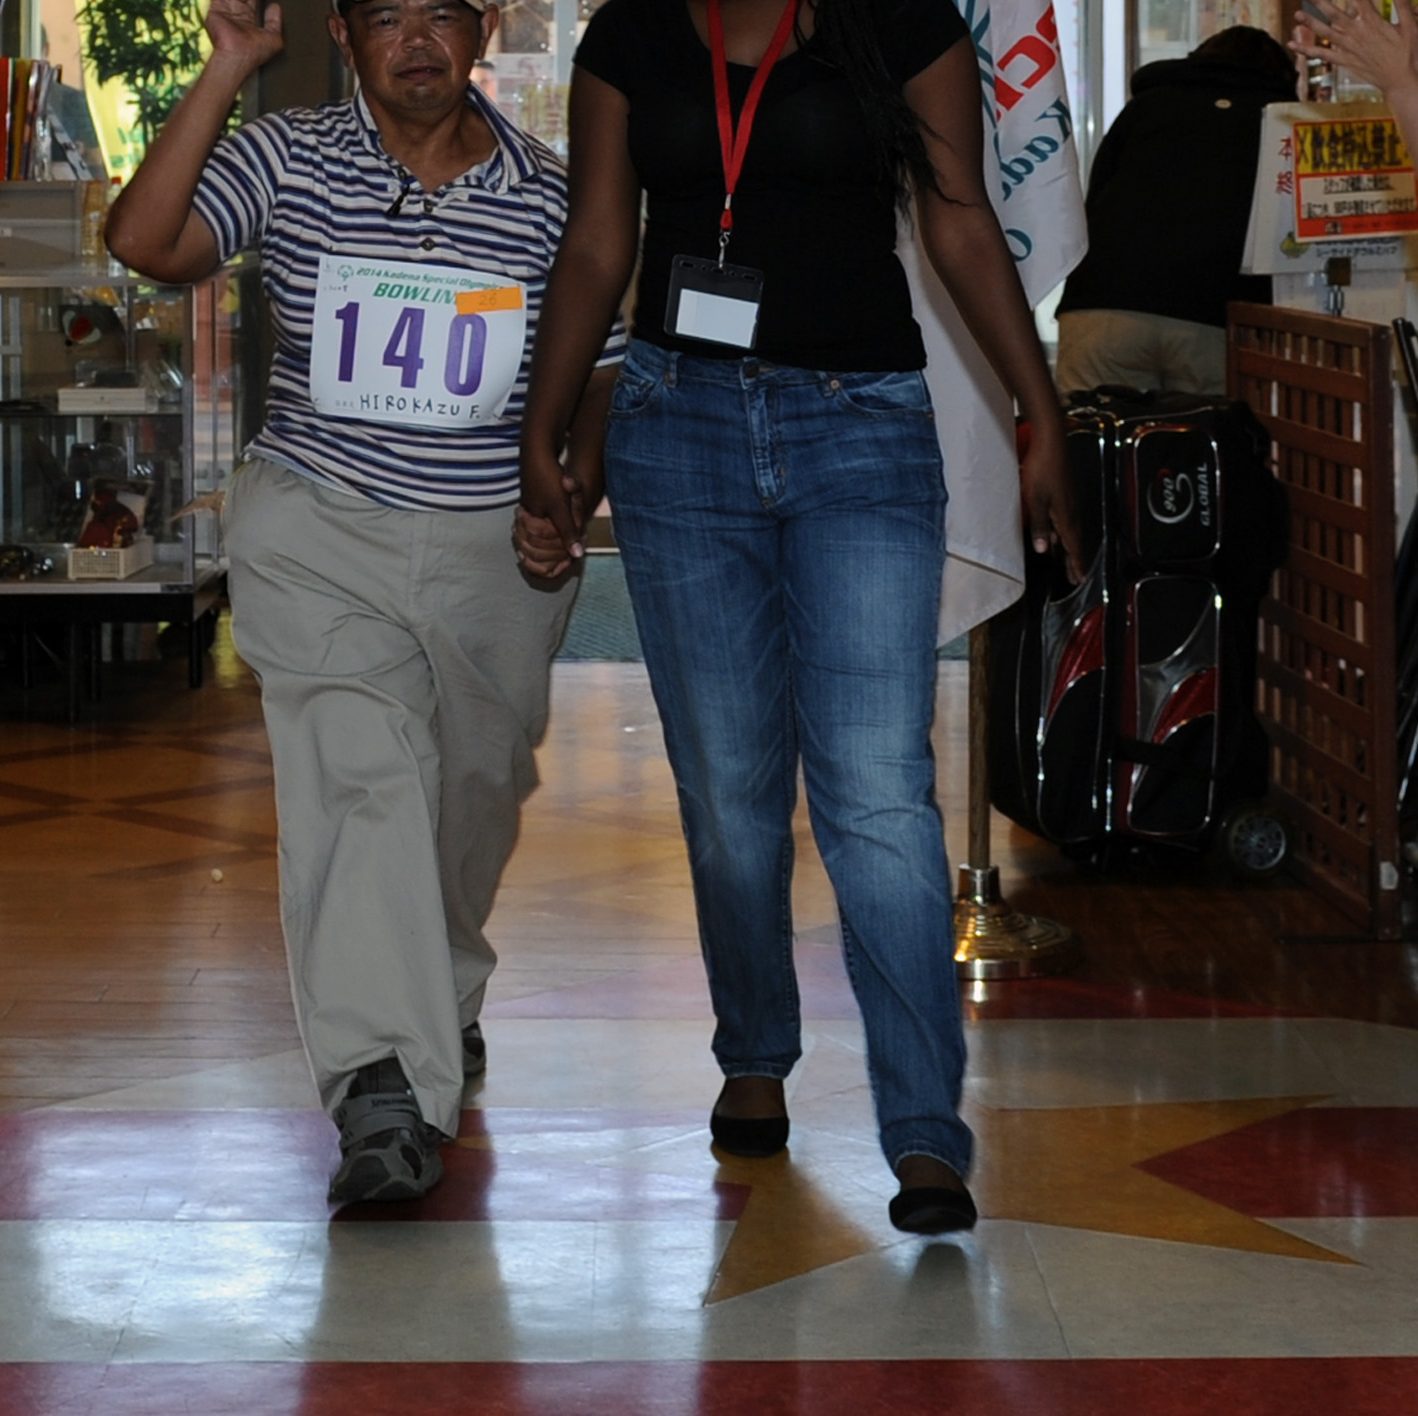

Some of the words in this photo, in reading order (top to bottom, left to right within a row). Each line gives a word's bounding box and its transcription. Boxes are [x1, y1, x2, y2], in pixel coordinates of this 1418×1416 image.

[357, 267, 381, 277] 2014
[384, 270, 421, 281] Kadena
[423, 275, 458, 287] Special
[373, 283, 457, 304] BOWLIN
[336, 302, 487, 396] 140
[360, 394, 460, 416] HIROKAZU
[1197, 462, 1211, 527] GLOBAL
